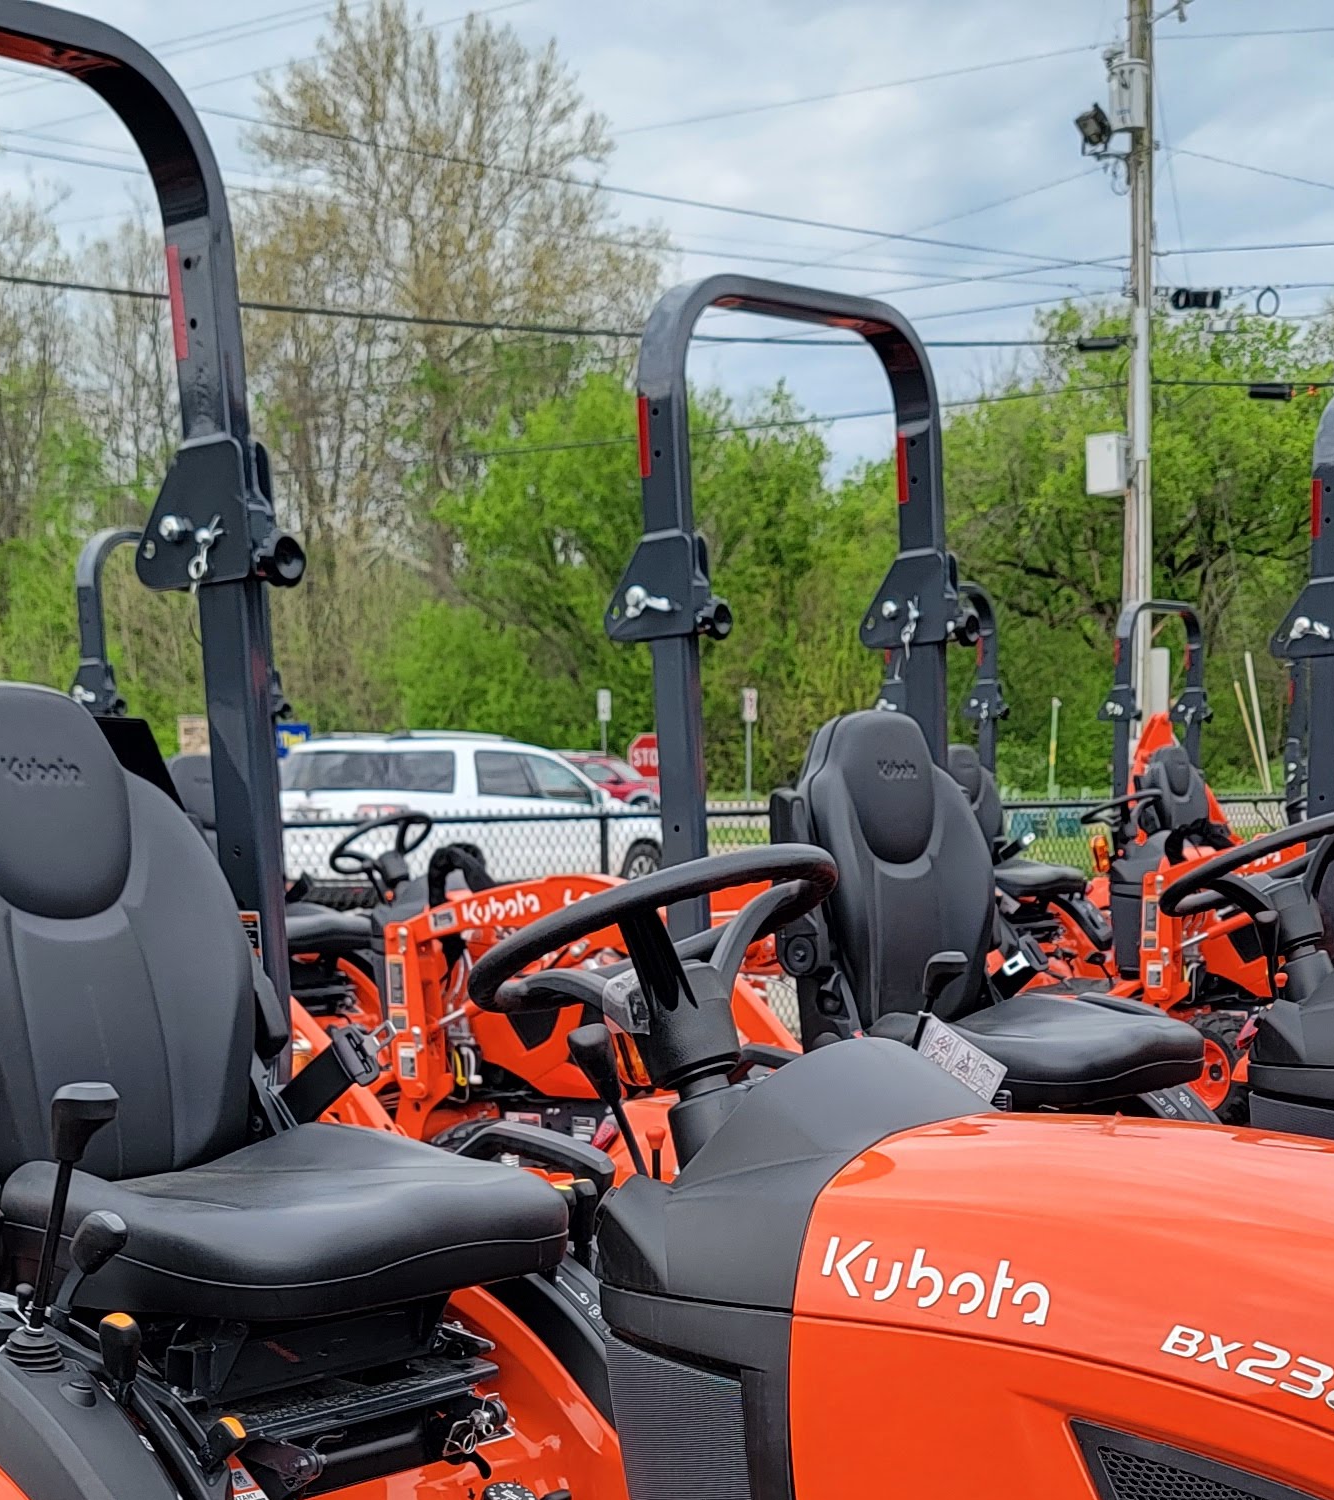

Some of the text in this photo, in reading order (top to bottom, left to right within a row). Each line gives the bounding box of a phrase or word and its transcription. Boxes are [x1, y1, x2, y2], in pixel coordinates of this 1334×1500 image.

[633, 747, 659, 767] STO
[461, 890, 541, 924] Kubota
[821, 1236, 1051, 1326] Kubota
